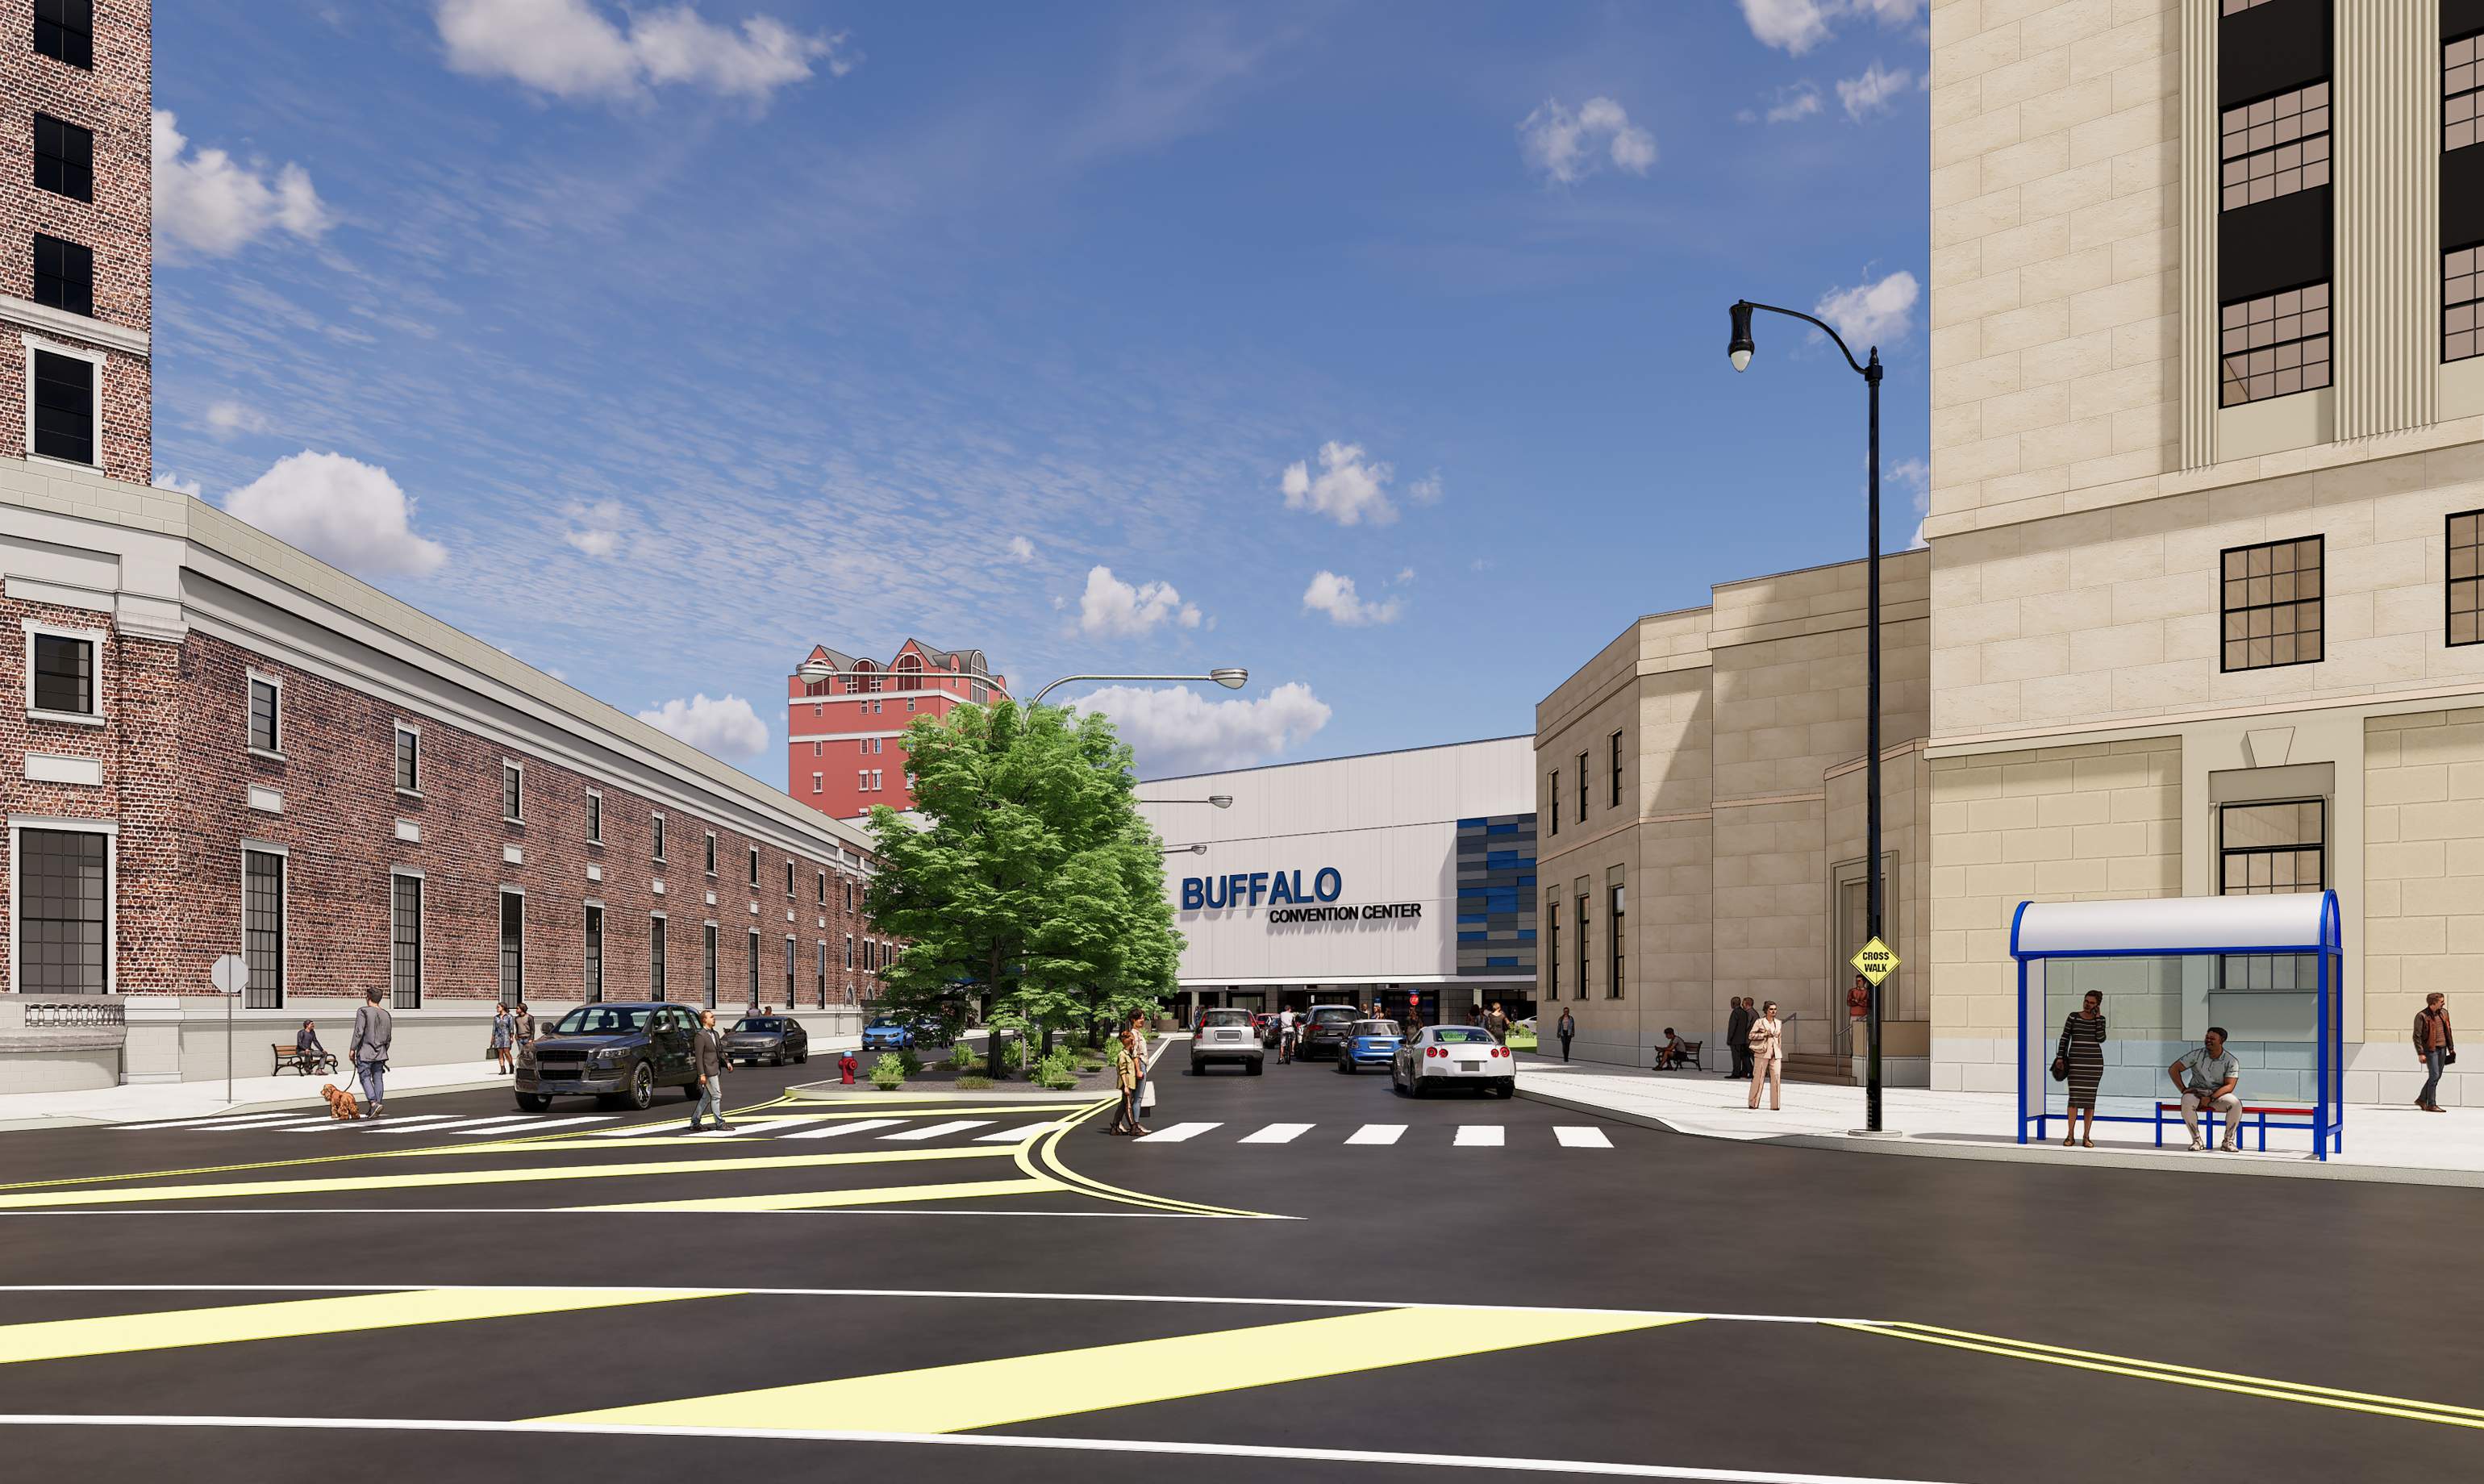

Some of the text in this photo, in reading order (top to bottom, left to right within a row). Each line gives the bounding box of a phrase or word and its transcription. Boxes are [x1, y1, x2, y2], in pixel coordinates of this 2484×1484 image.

[1182, 867, 1342, 911] BUFFALO
[1269, 903, 1422, 923] CONVENTION CENTER
[1862, 952, 1890, 961] CROSS
[1864, 963, 1887, 973] WALK
